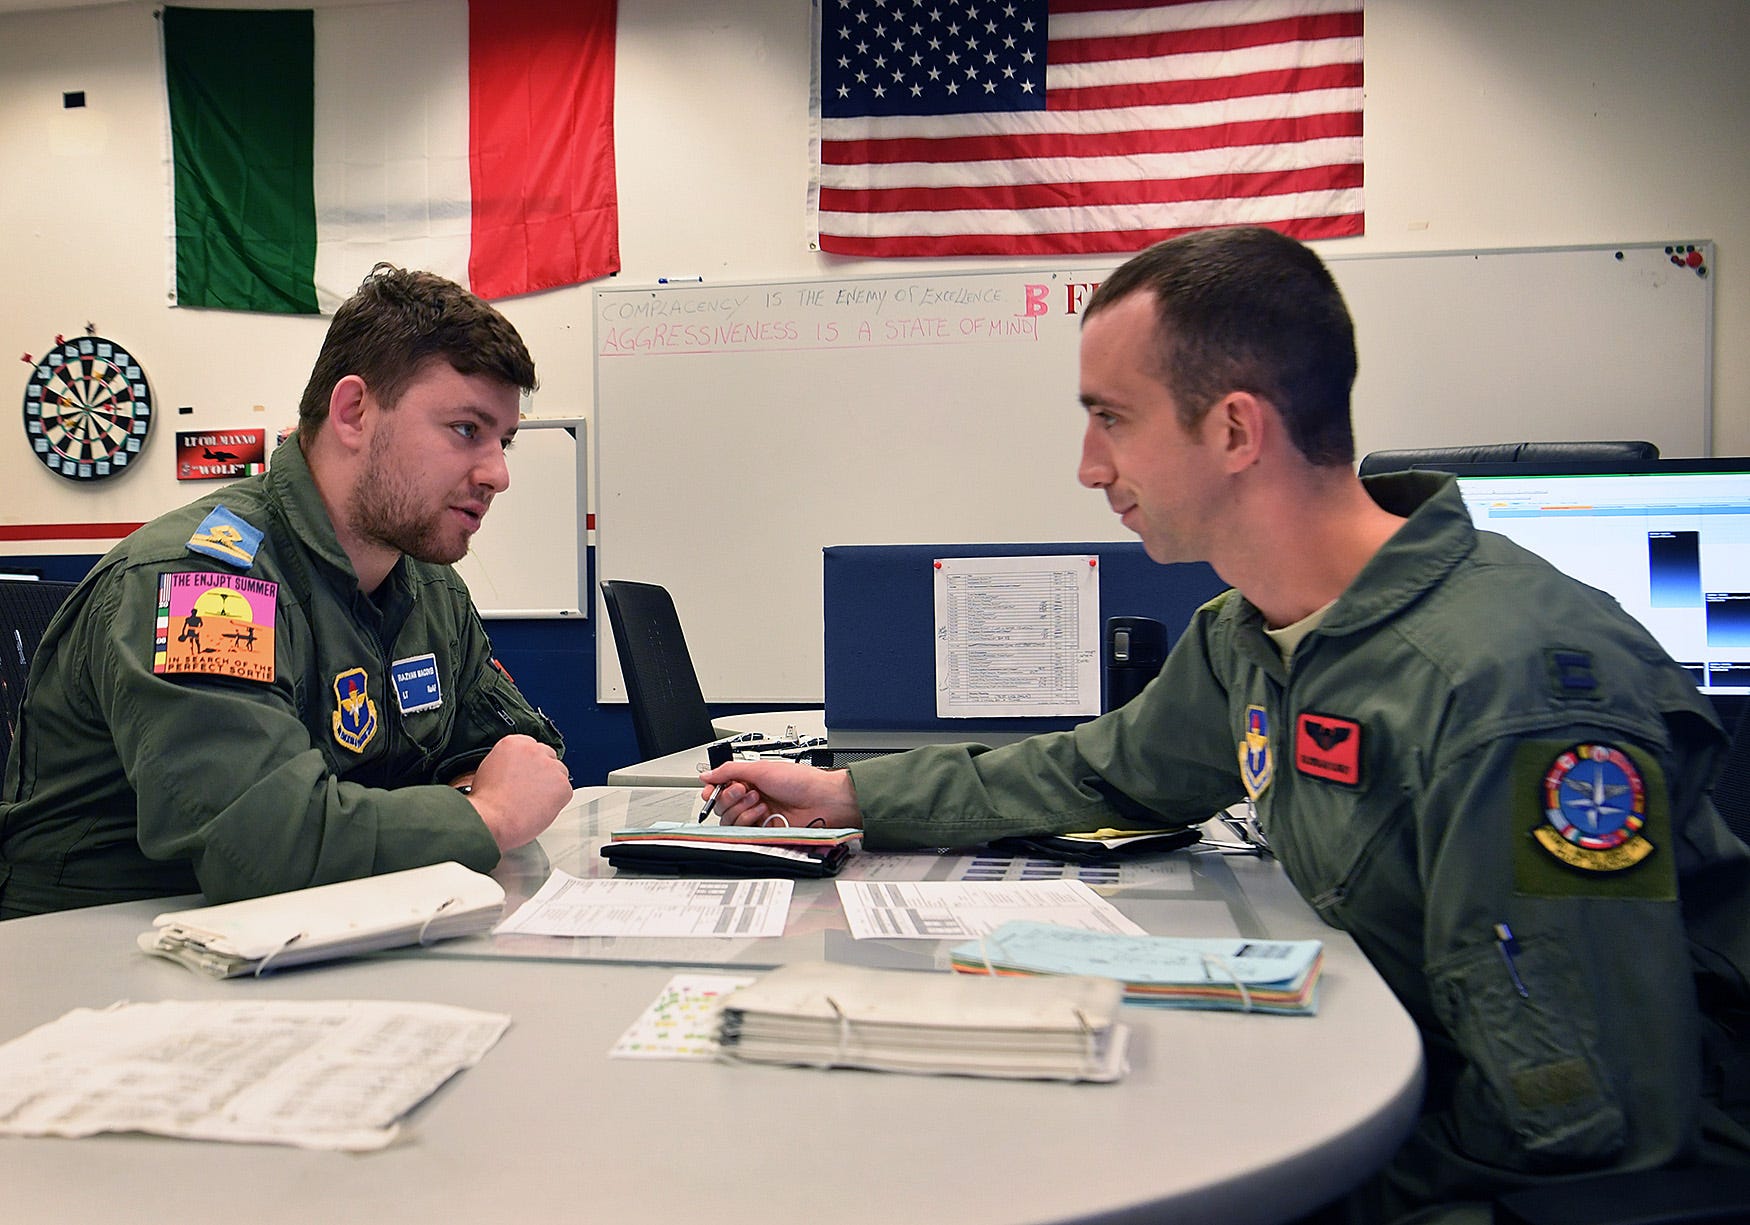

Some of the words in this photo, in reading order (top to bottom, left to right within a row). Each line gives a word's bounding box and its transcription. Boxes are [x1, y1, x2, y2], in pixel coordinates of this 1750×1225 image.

[602, 296, 749, 322] COMPLACENCY
[766, 292, 783, 308] IS
[800, 289, 825, 307] THE
[836, 287, 887, 314] ENEMY
[894, 285, 919, 302] OF
[919, 287, 1002, 306] EXCELLENCE
[604, 320, 800, 351] AGGRESSIVENESS
[816, 321, 839, 341] IS
[858, 320, 872, 341] A
[885, 317, 950, 340] STATE
[959, 317, 985, 337] OF
[198, 436, 218, 447] COL
[173, 574, 191, 587] THE
[194, 574, 232, 589] ENJJPT
[235, 577, 276, 598] SUMMER
[168, 663, 223, 672] PERFECT
[229, 666, 272, 680] SORTIE
[186, 656, 229, 664] SEARCH
[254, 663, 272, 672] THE
